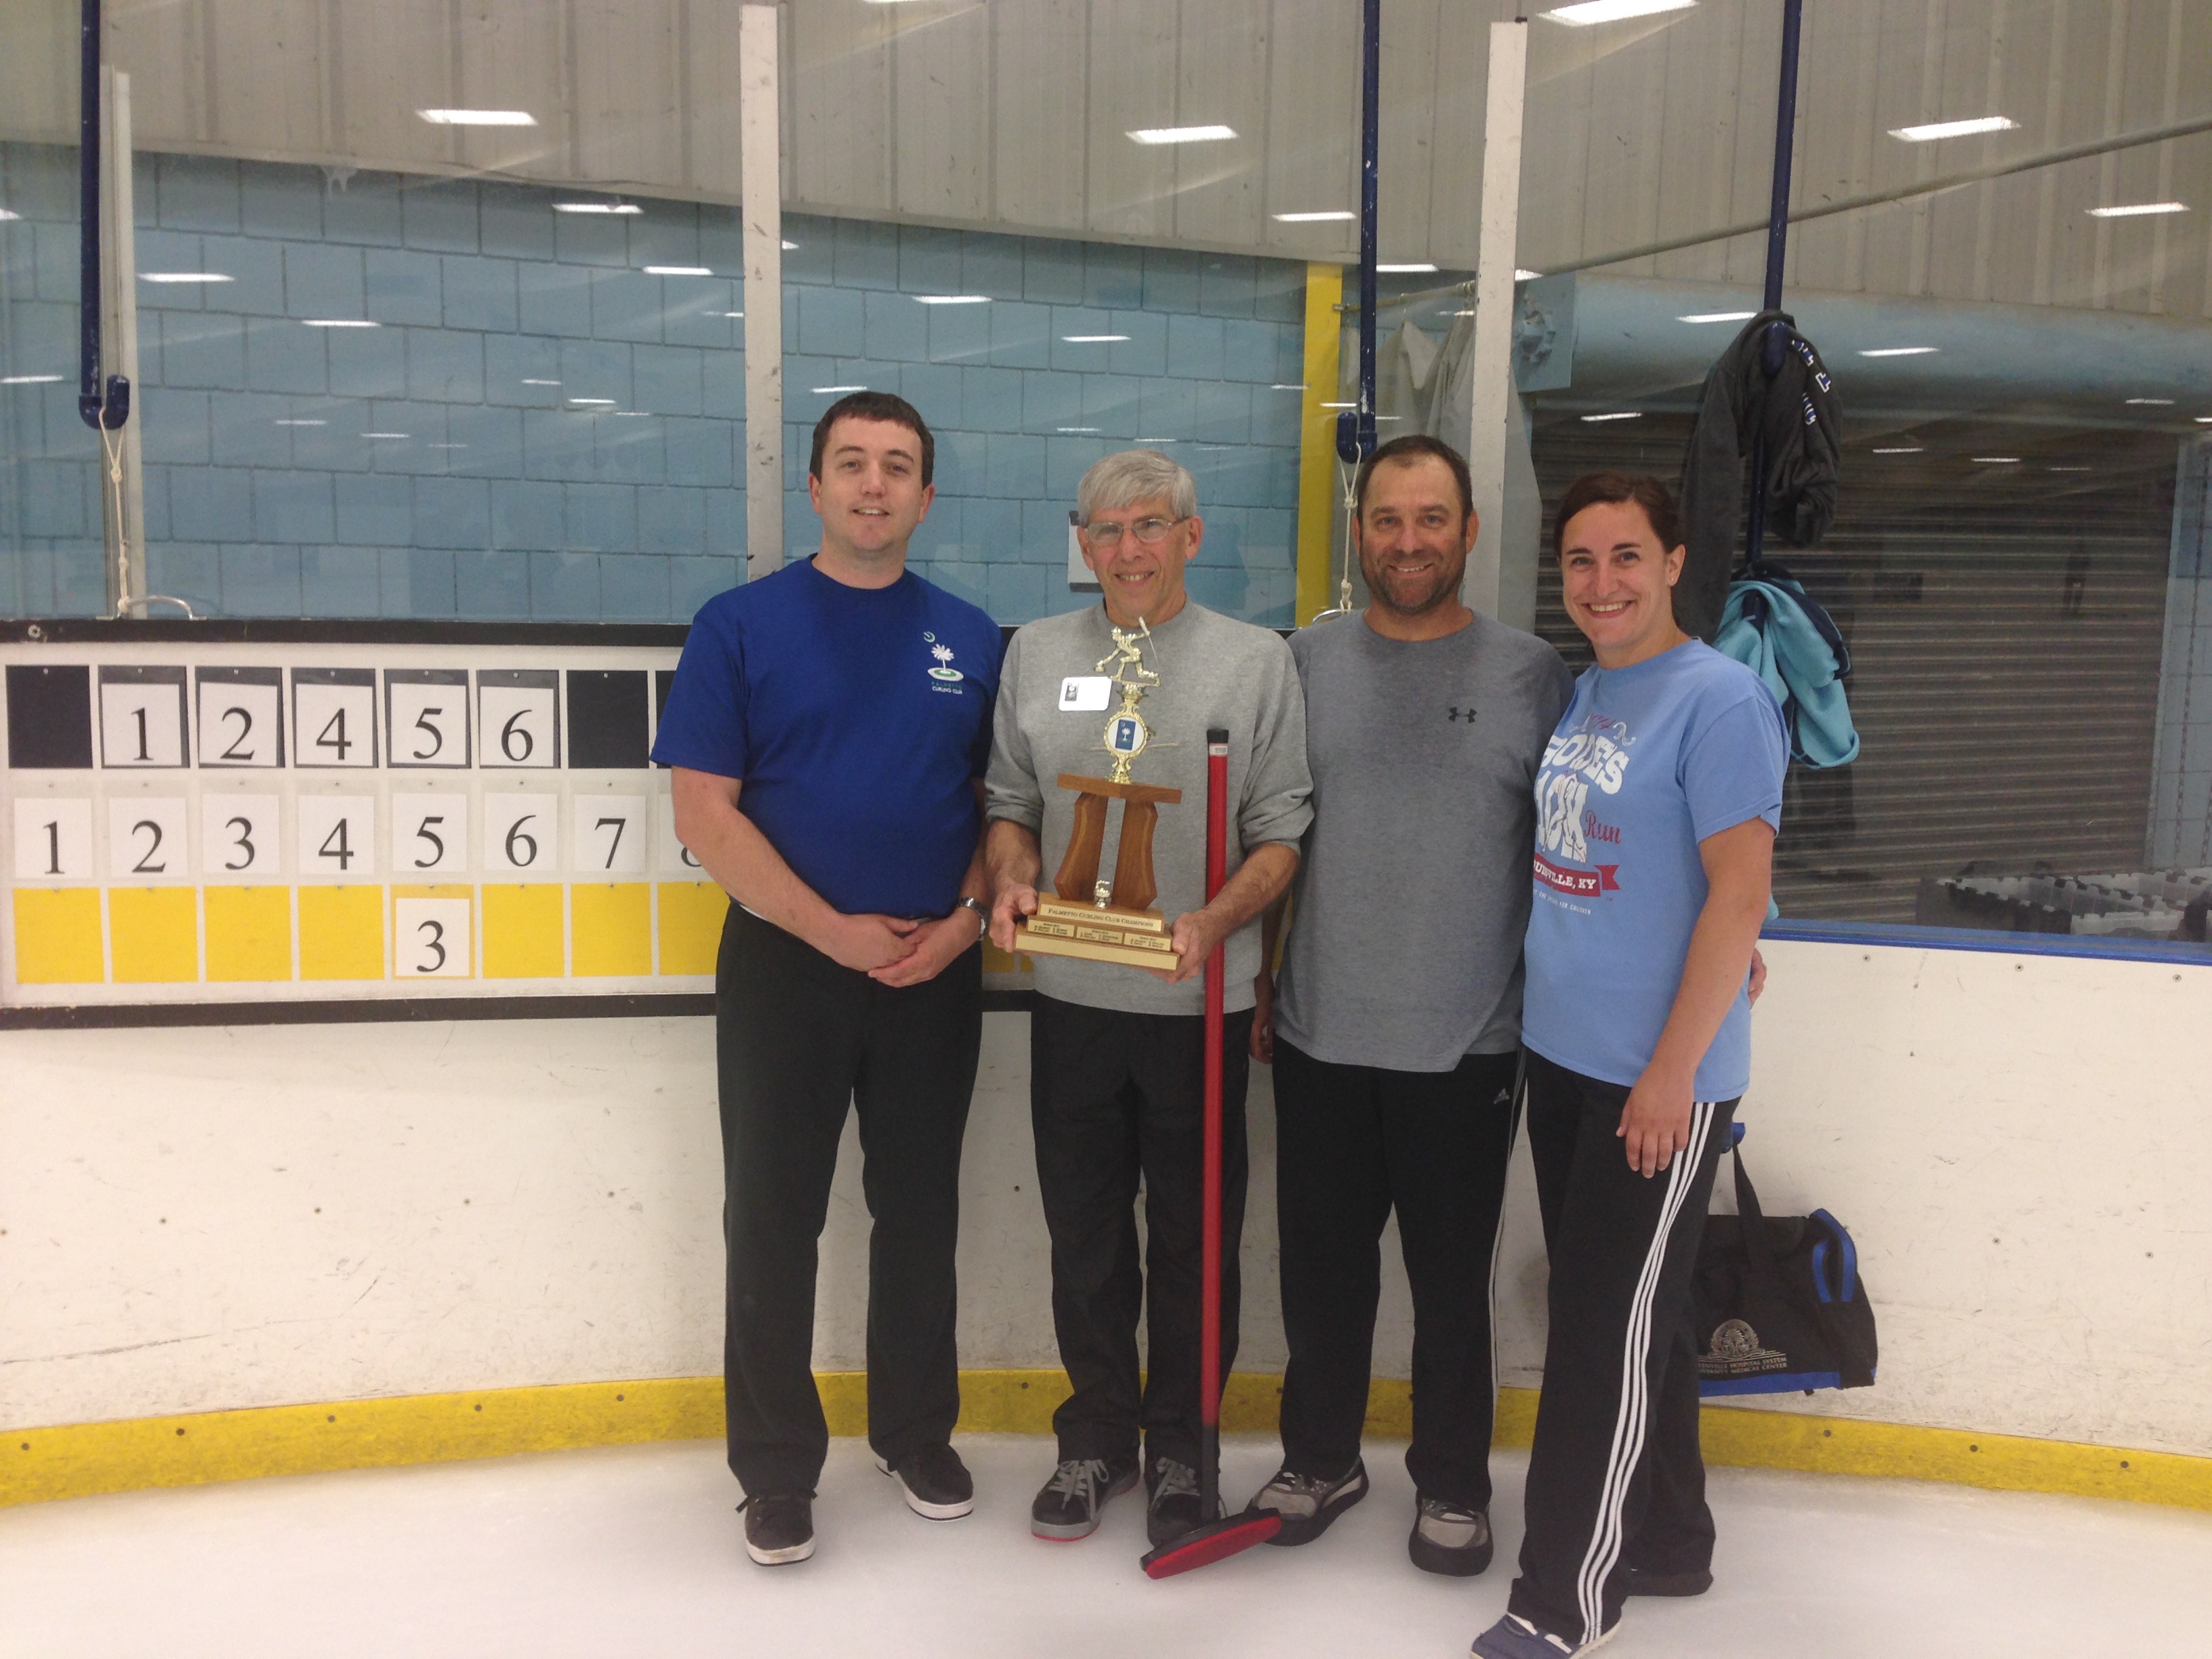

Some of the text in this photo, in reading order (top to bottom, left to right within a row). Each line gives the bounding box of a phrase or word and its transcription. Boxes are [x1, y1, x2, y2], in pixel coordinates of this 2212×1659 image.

[131, 708, 533, 762] 1 2 4 5 6
[43, 821, 62, 874] 1
[131, 821, 166, 873] 2
[225, 817, 255, 869] 3
[318, 818, 354, 870] 4
[414, 816, 445, 868] 5
[505, 815, 537, 867] 6
[594, 817, 626, 869] 7
[1584, 809, 1622, 845] Run
[1578, 878, 1597, 890] KY
[1048, 907, 1078, 918] PALMETTO
[1079, 912, 1103, 921] CURLING
[415, 920, 446, 972] 3
[1729, 1360, 1761, 1368] HOSPITAL
